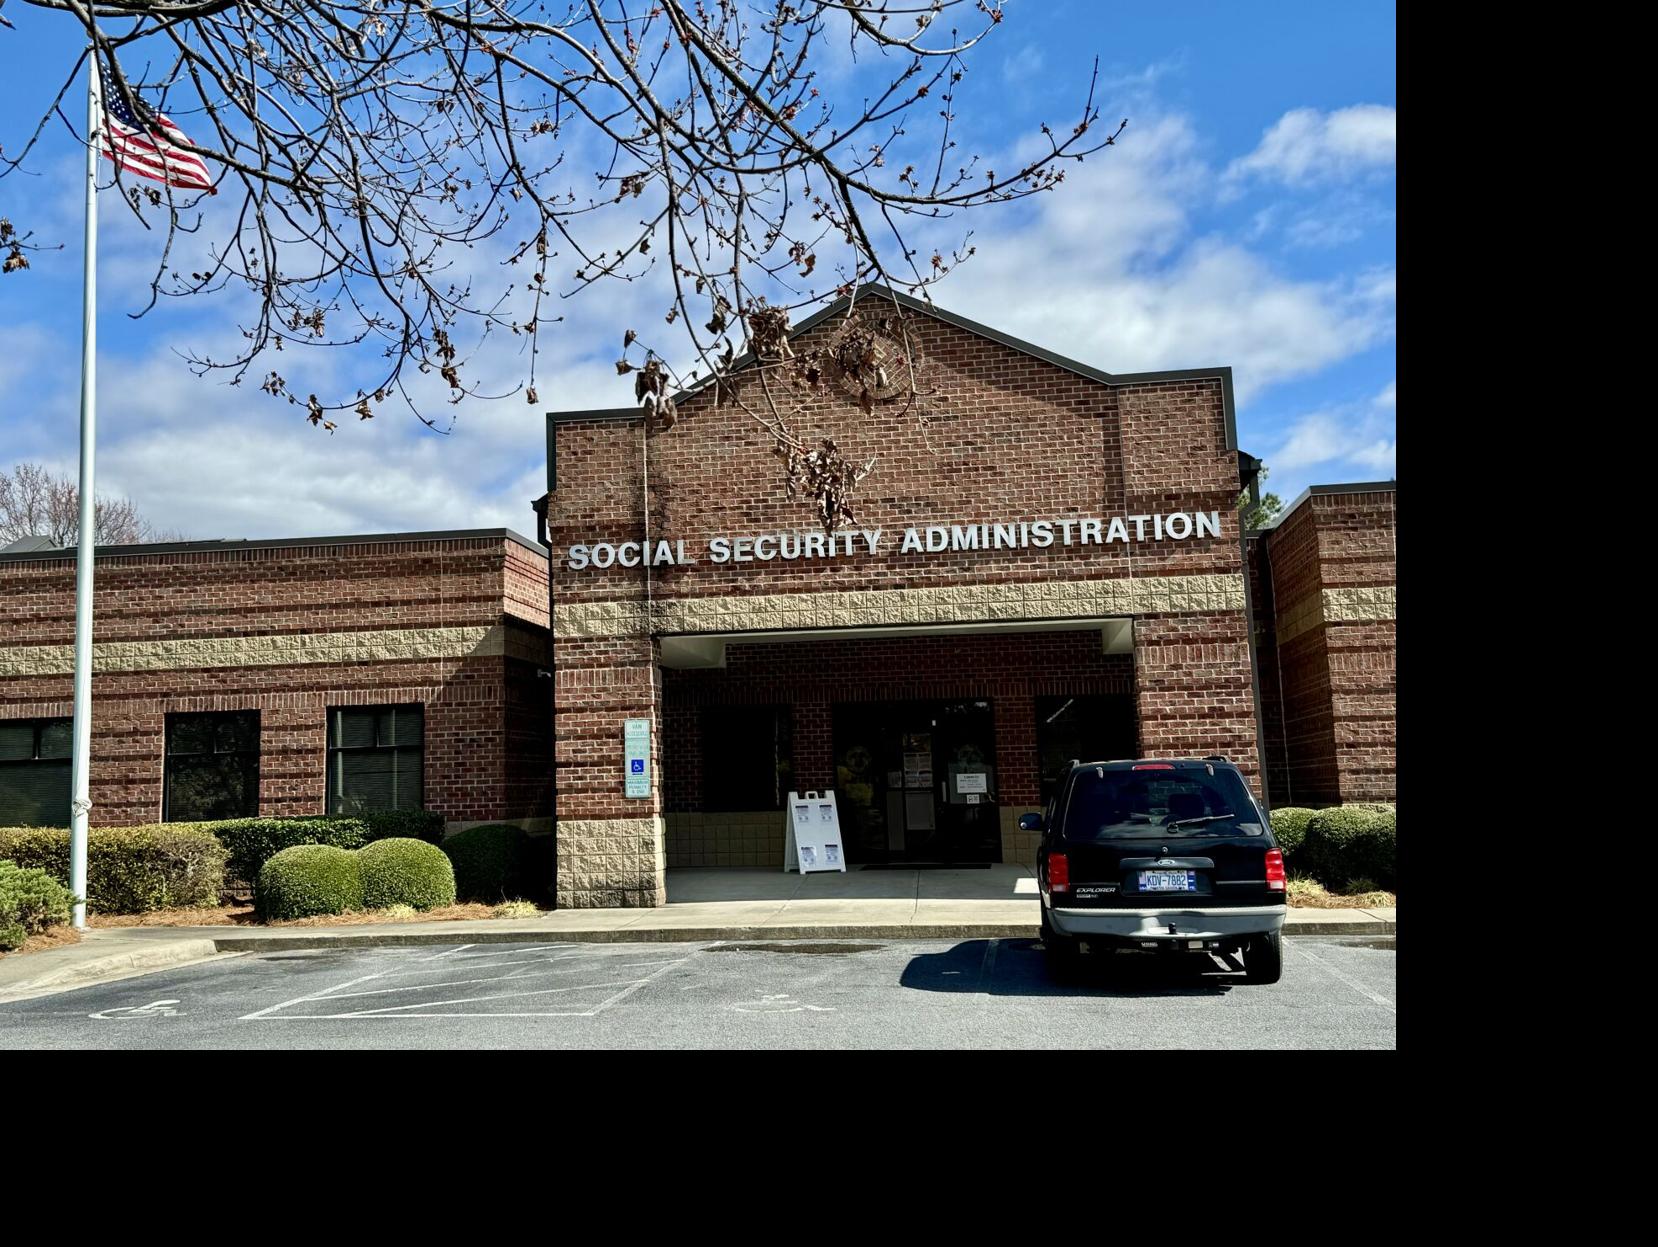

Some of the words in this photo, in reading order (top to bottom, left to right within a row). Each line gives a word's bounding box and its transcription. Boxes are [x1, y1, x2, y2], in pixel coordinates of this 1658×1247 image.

[568, 540, 695, 570] SOCIAL
[710, 529, 881, 563] SECURITY
[901, 511, 1221, 554] ADMINISTRATION
